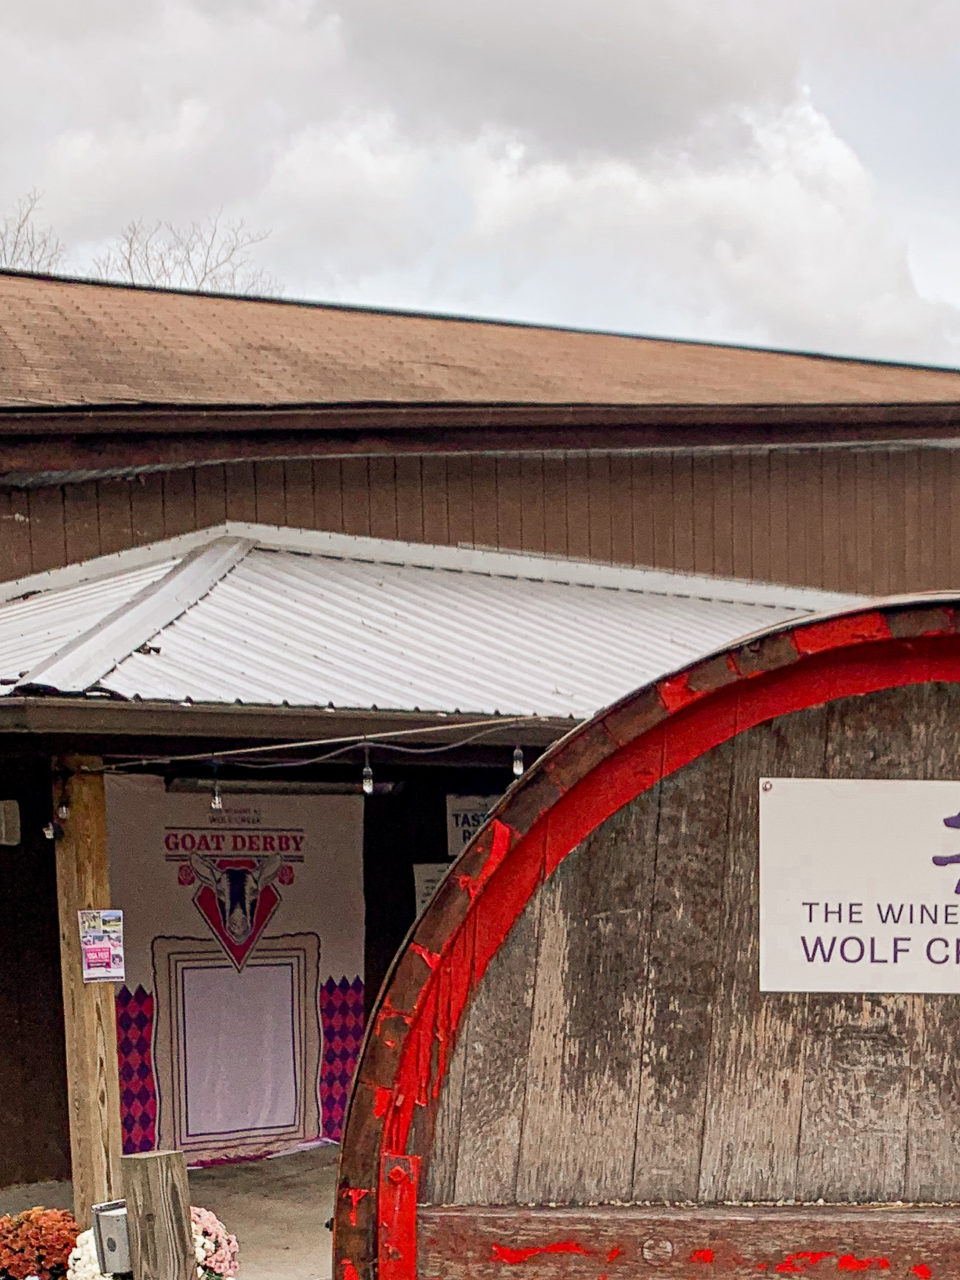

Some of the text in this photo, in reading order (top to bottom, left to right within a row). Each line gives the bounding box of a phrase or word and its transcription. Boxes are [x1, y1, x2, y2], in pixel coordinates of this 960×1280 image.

[164, 833, 304, 852] GOAT DERBY
[801, 902, 863, 923] THE
[800, 936, 912, 964] WOLF
